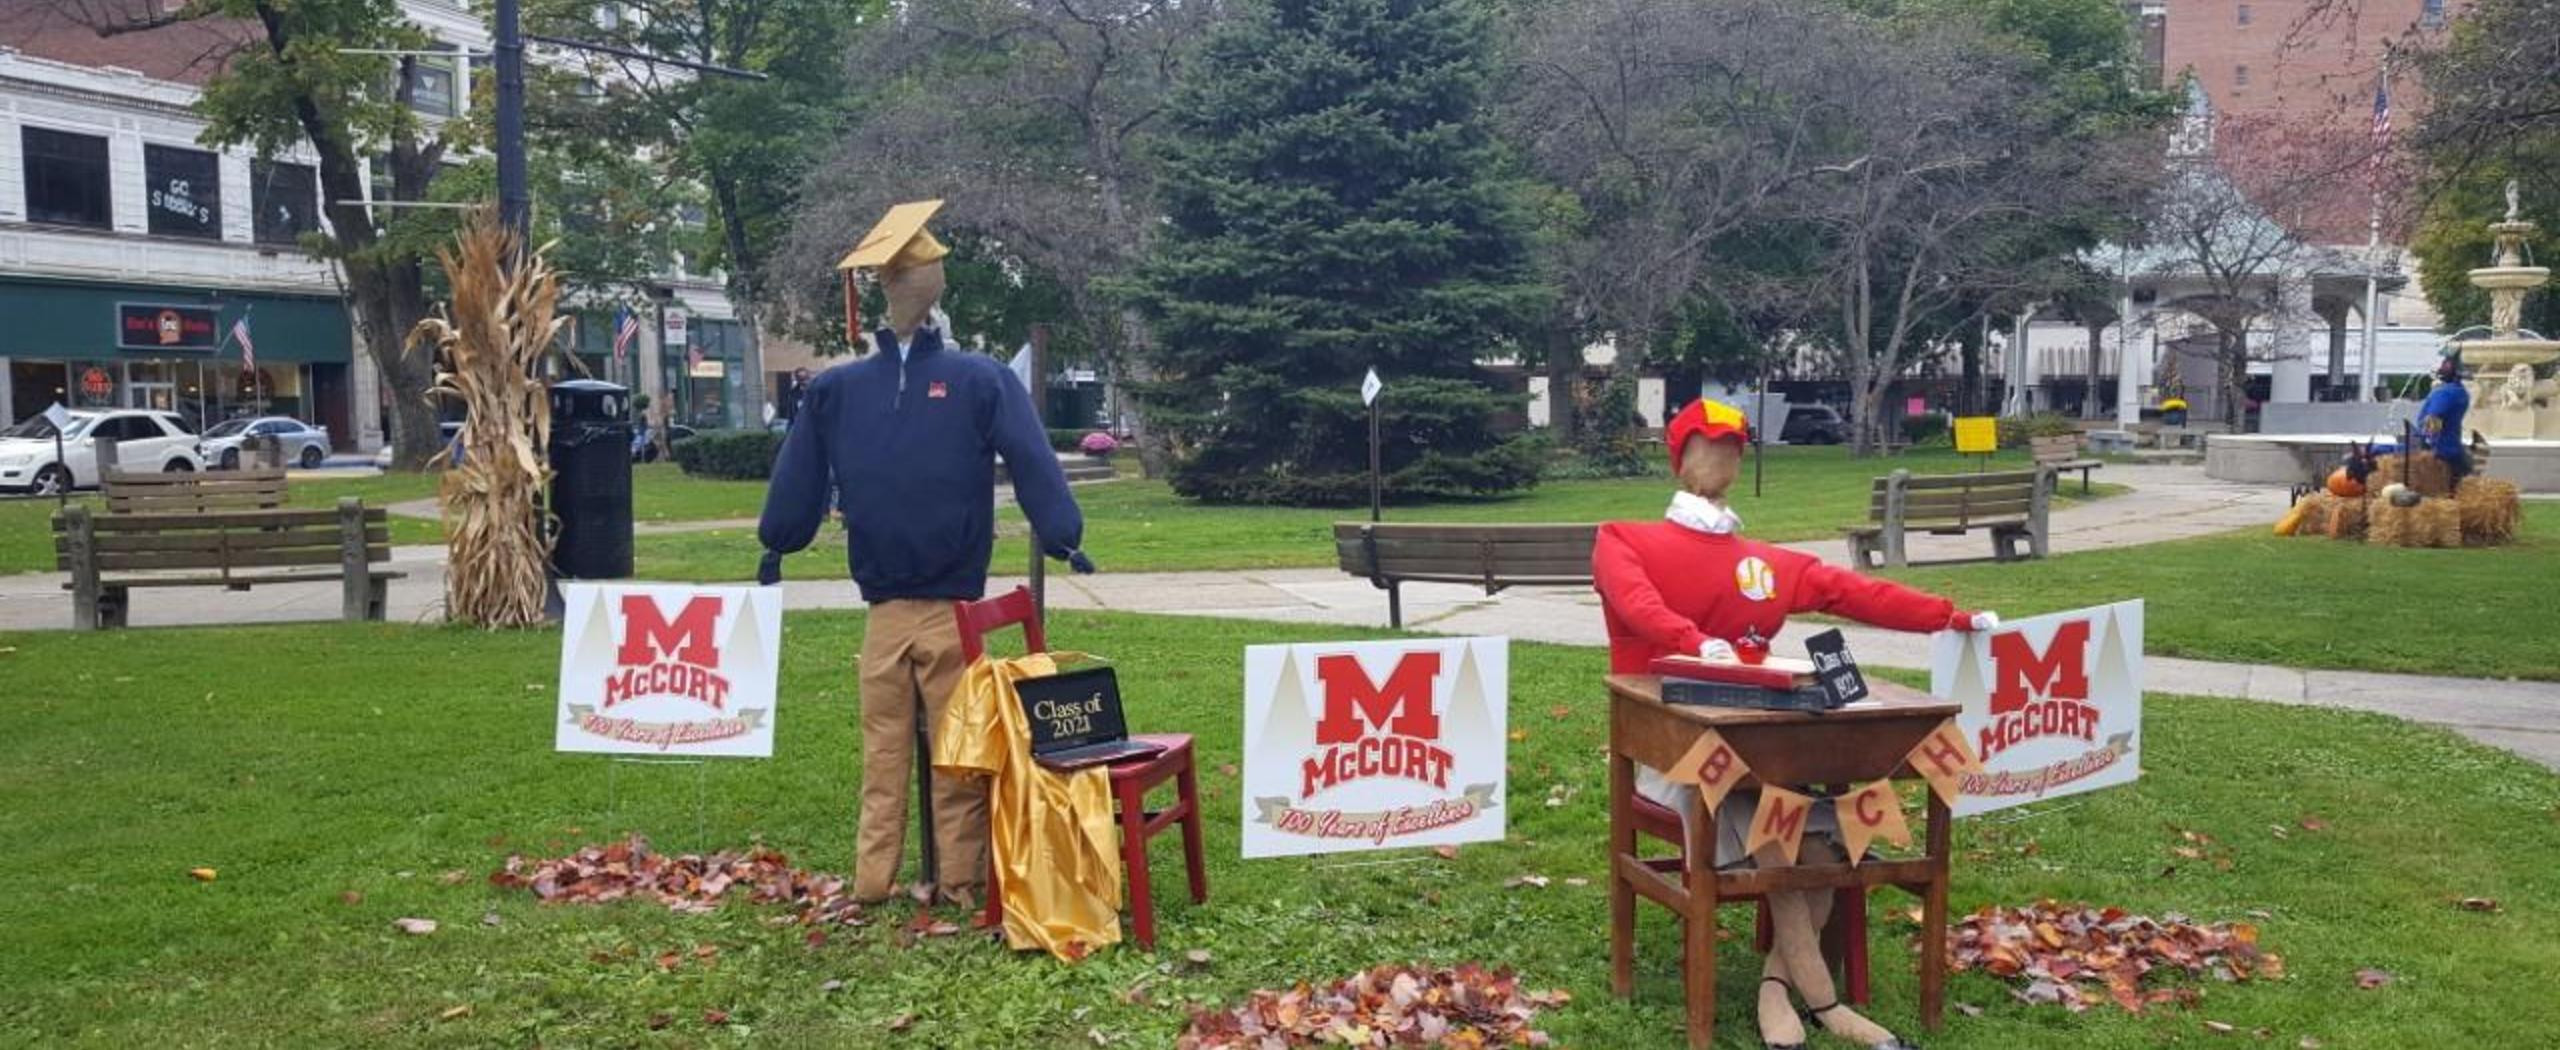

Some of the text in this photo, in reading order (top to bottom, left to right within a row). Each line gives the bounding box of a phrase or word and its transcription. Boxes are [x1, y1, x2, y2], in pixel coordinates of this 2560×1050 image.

[617, 594, 723, 669] M
[1989, 619, 2091, 716] M
[1033, 692, 1102, 720] Class of
[1051, 714, 1092, 739] 2021
[1315, 652, 1441, 745] M
[1698, 731, 1967, 842] B M C H
[1278, 808, 1313, 833] 100
[1316, 807, 1364, 839] Years
[1367, 810, 1390, 845] of
